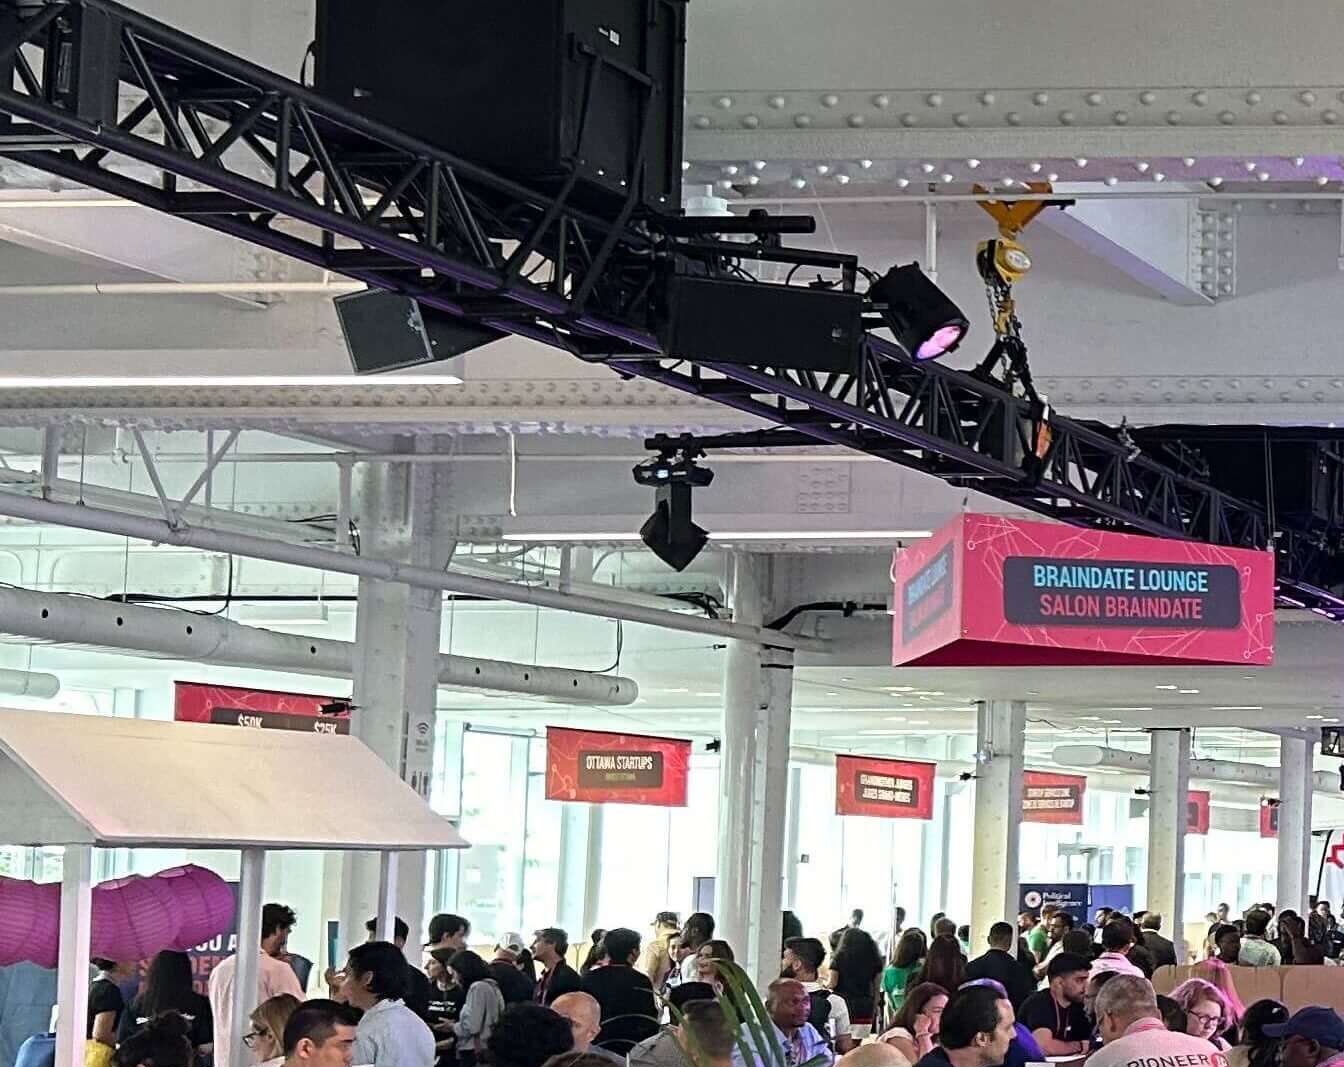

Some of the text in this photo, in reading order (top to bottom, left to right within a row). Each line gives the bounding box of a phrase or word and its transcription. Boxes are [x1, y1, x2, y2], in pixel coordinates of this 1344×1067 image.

[1033, 565, 1209, 592] BRAINDATE LOUNGE
[1040, 594, 1203, 619] SALON BRAINDATE
[586, 755, 653, 770] OTTAWA STARTUPS
